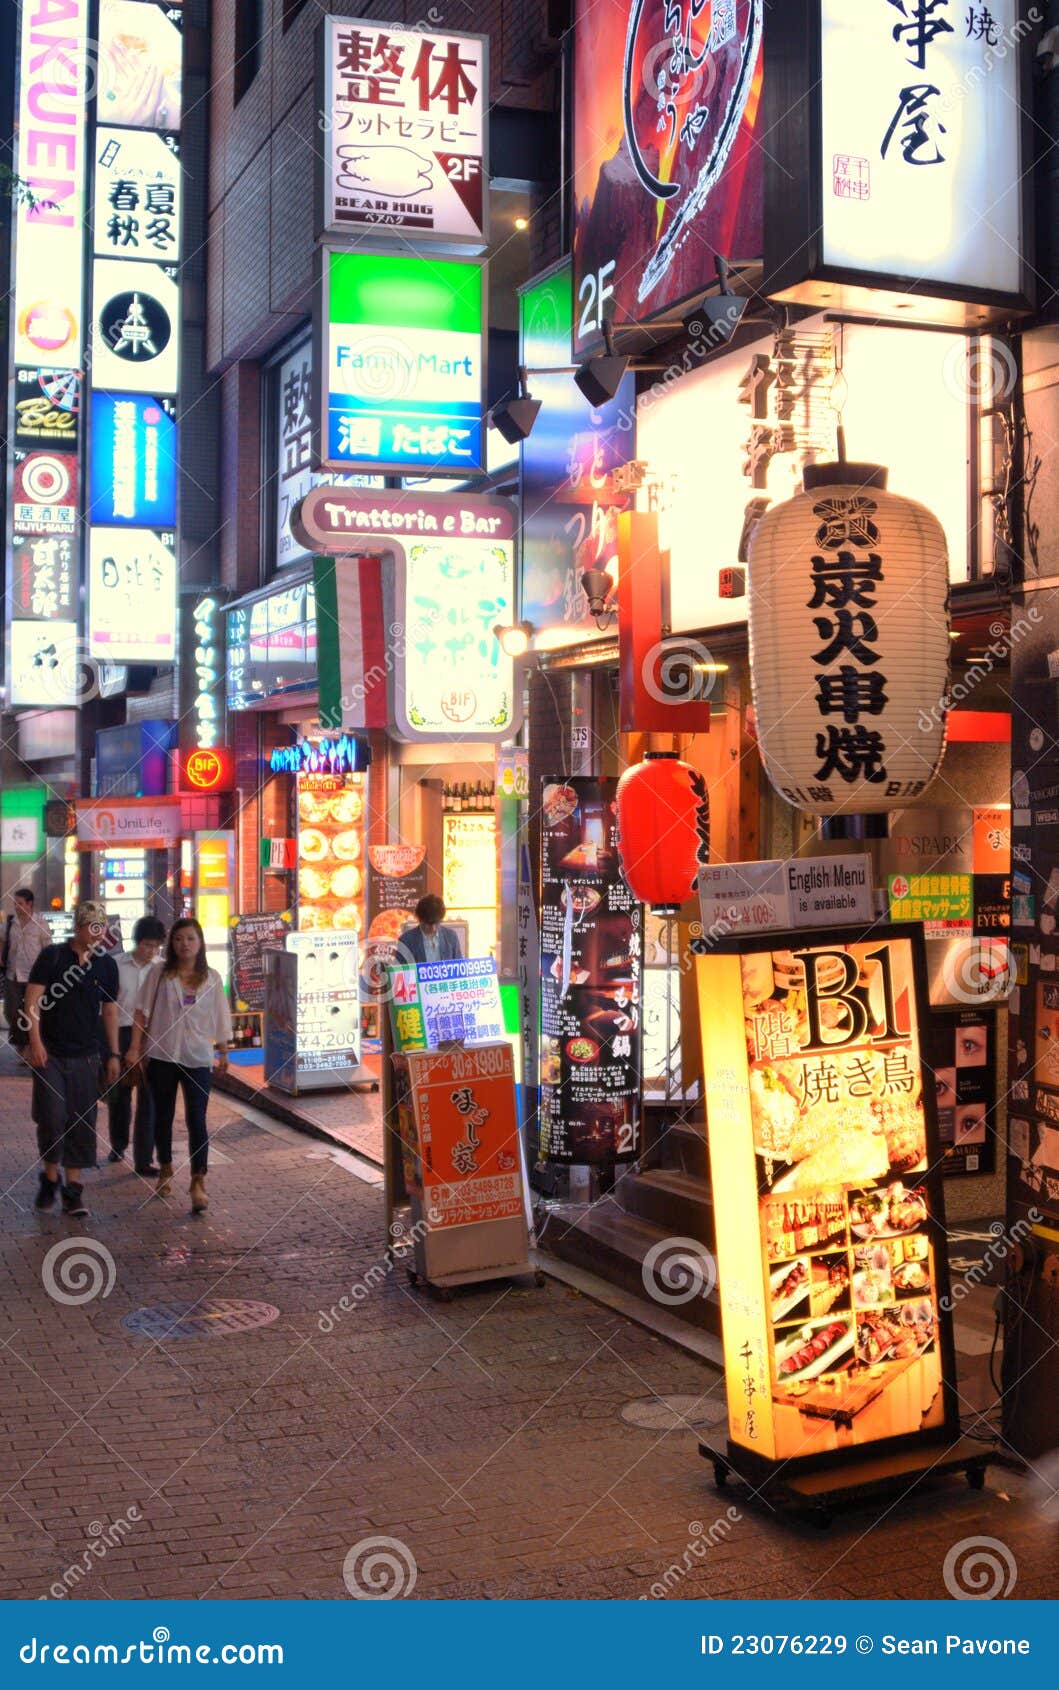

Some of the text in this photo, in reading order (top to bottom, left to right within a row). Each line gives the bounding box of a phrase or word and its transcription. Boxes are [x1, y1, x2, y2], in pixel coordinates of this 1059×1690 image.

[336, 30, 478, 116] 整体
[335, 110, 478, 143] フットセラピー
[447, 158, 479, 182] 2F
[335, 197, 433, 215] BEAR HUG
[364, 212, 405, 225] ベアハグ
[578, 259, 616, 339] 2F
[336, 345, 473, 377] FamilyMart
[18, 369, 38, 383] 8F
[337, 415, 472, 456] 酒 たばこ
[20, 505, 73, 521] 居酒屋
[324, 502, 501, 534] Trattoria e Bar
[806, 551, 890, 784] 炭火串焼
[450, 692, 471, 706] BIF
[195, 759, 216, 773] BIF
[117, 817, 162, 829] UniLife
[447, 819, 484, 832] Pizza
[788, 865, 866, 893] English Menu
[800, 897, 857, 912] is available
[392, 972, 417, 1003] 4F
[793, 944, 912, 1051] B1
[425, 998, 498, 1017] クイックマッサージ
[396, 1007, 424, 1041] 健
[752, 1010, 793, 1062] 階
[298, 1031, 356, 1049] ¥4,200
[798, 1051, 916, 1109] 焼き鳥
[617, 1120, 641, 1154] 2F
